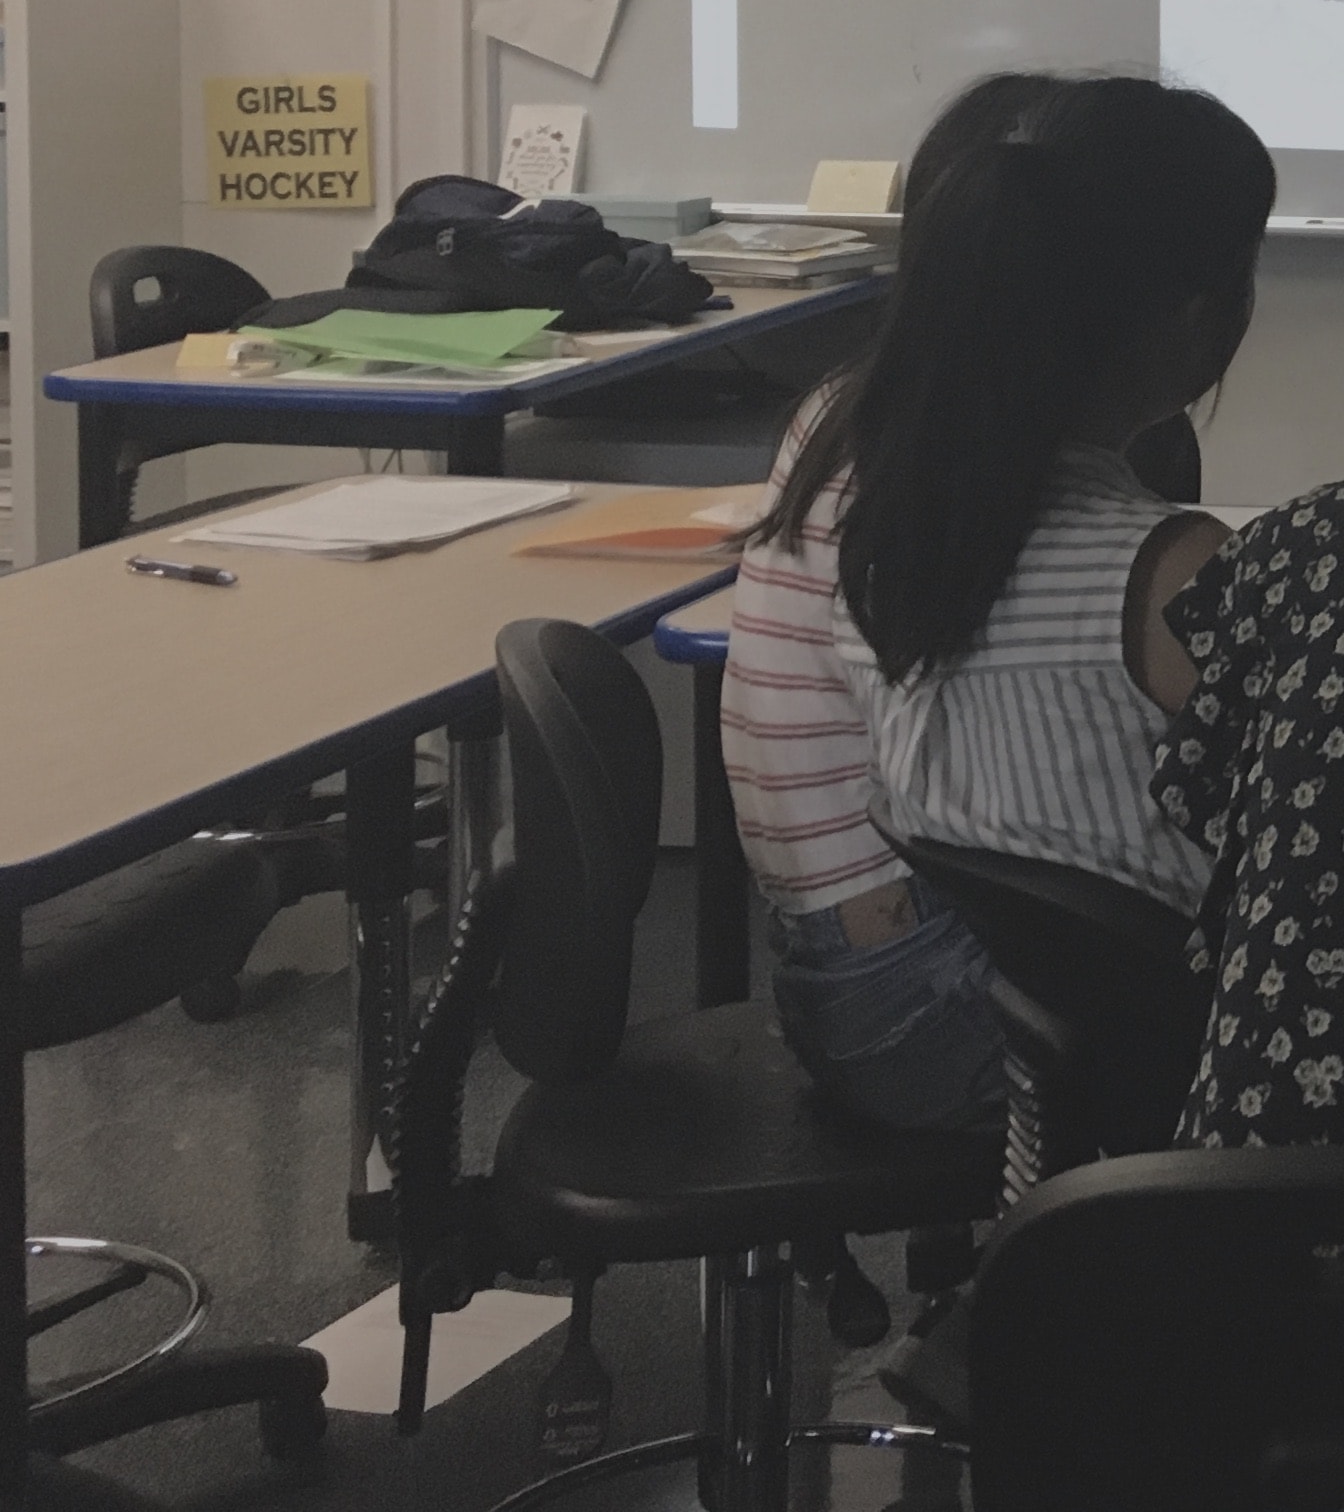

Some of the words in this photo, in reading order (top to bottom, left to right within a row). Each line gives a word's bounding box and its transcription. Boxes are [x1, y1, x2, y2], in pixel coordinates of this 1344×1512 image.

[236, 85, 338, 114] GIRLS
[217, 128, 359, 157] VARSITY
[219, 171, 360, 201] HOCKEY
